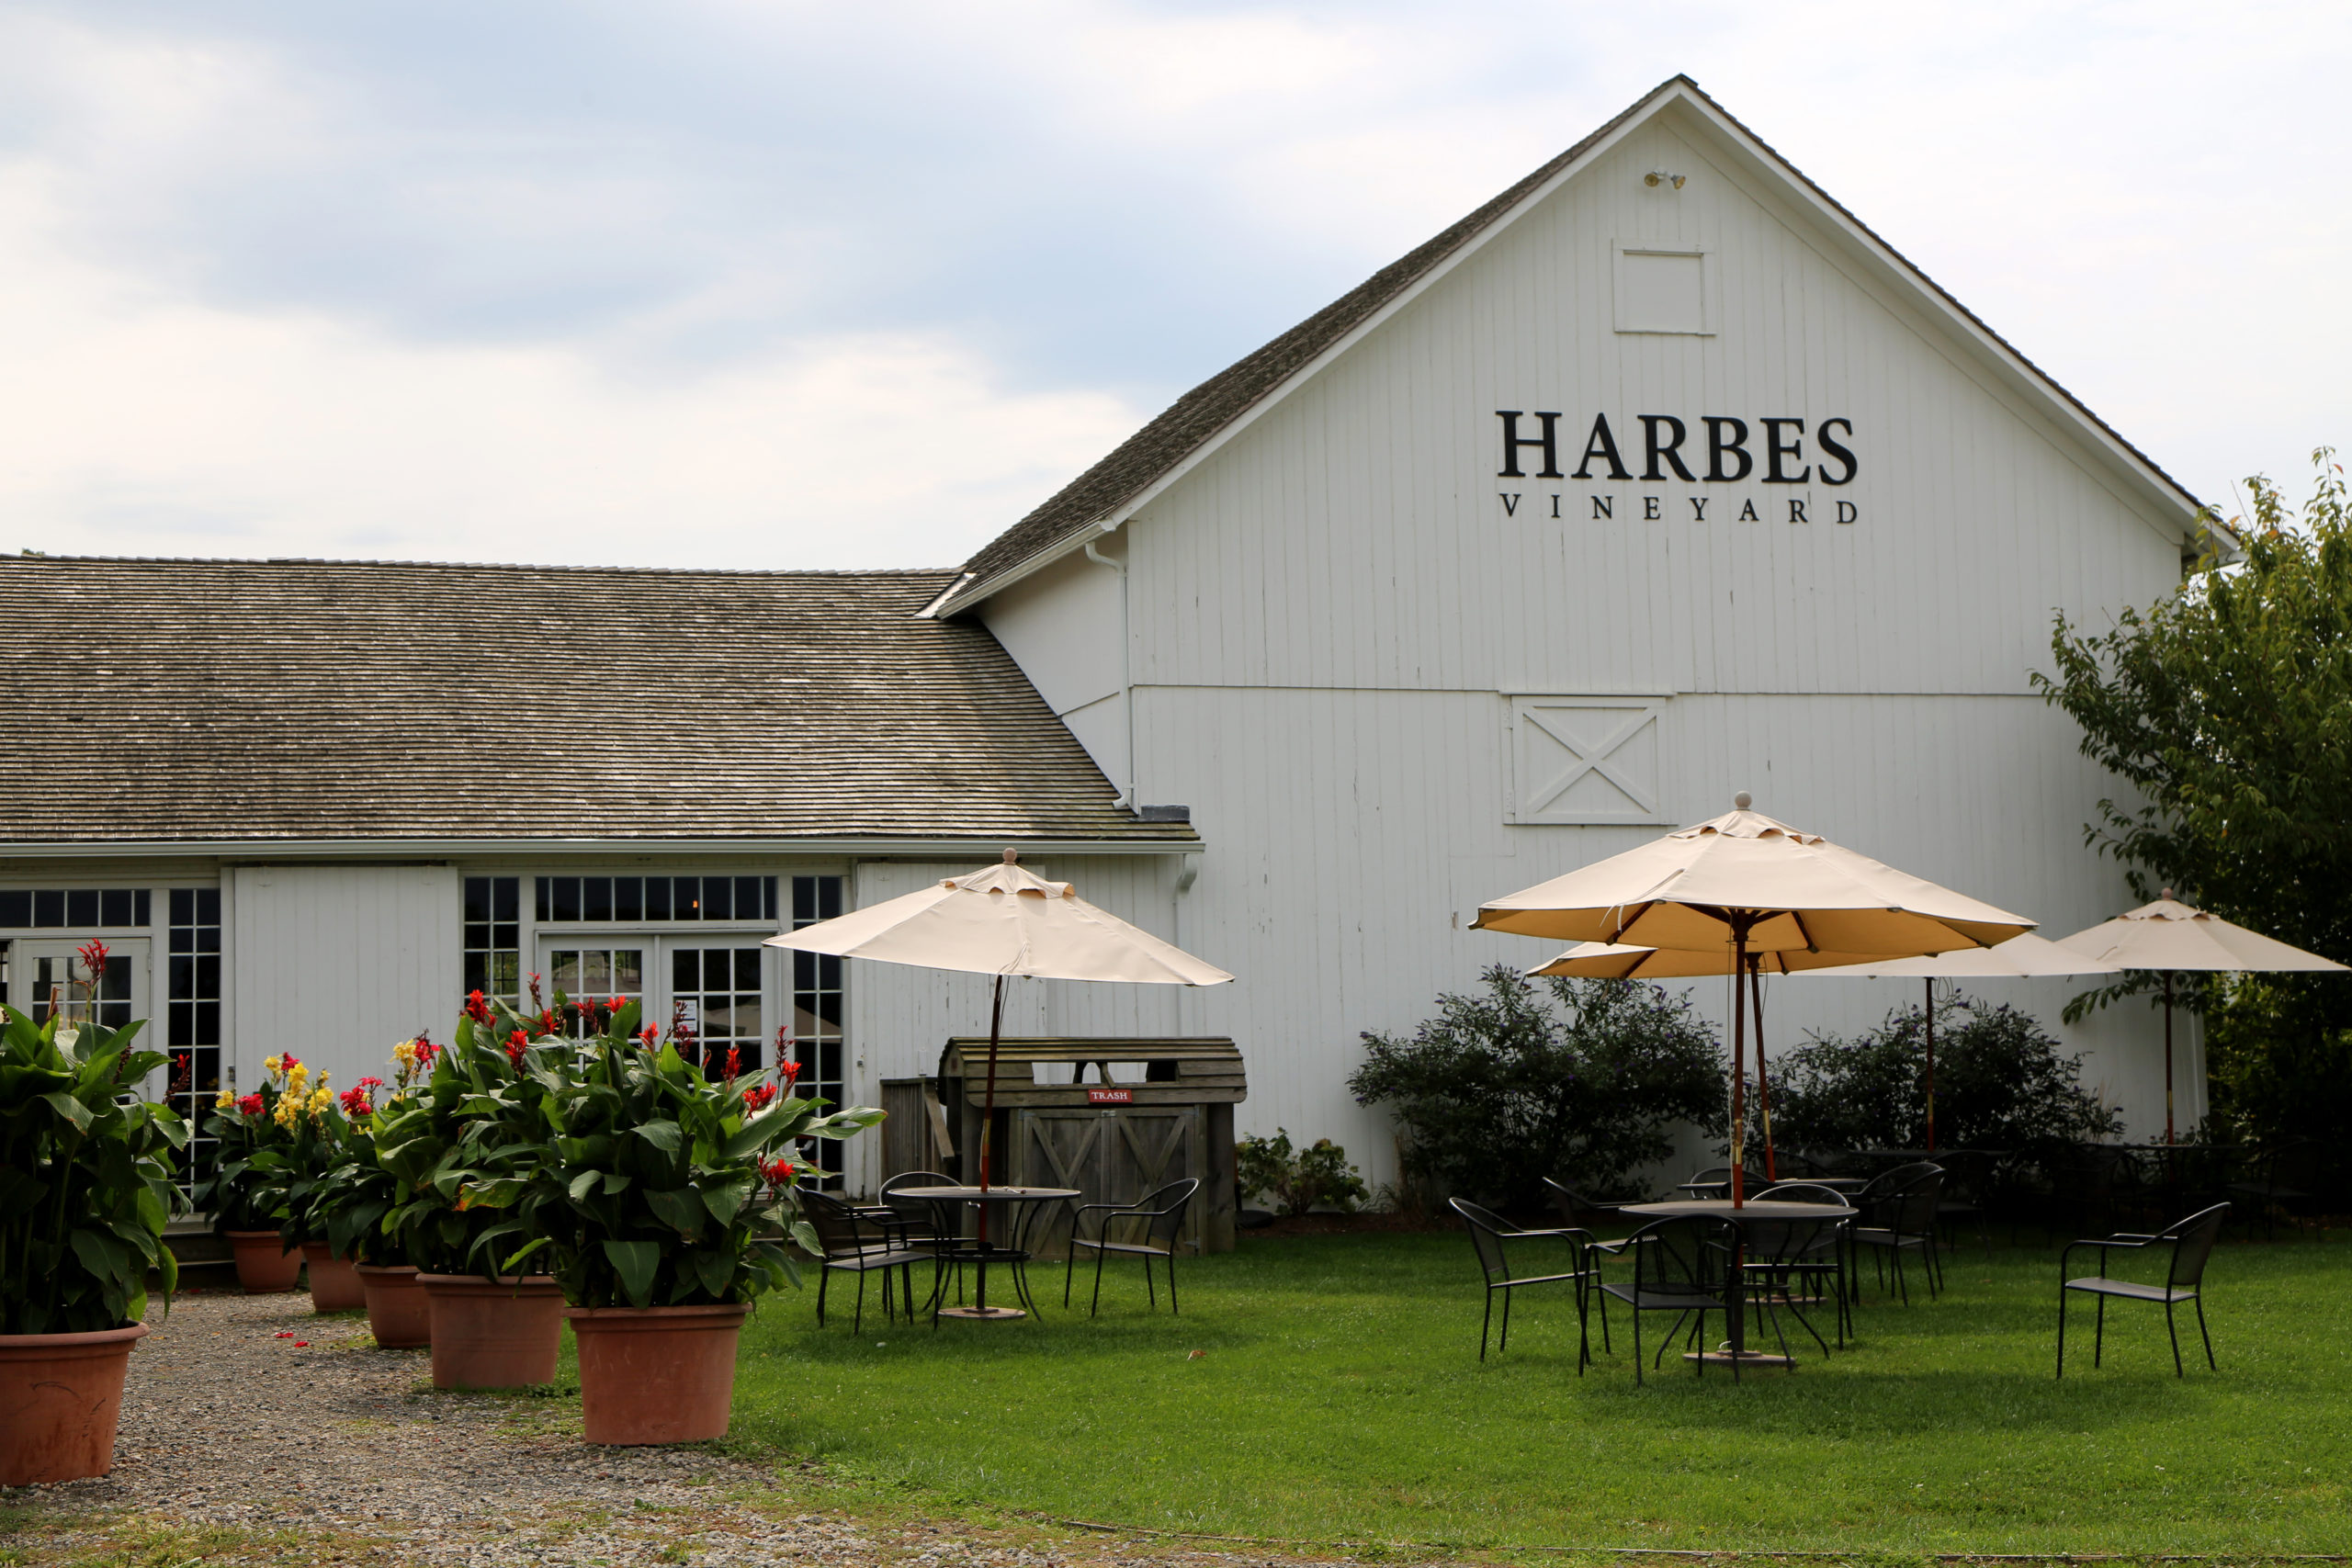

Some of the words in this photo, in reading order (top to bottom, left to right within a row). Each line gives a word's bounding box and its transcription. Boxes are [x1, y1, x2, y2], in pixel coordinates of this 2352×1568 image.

[1495, 410, 1858, 487] HARBES
[1498, 492, 1858, 525] VINEYARD
[1091, 1091, 1128, 1100] TRASH
